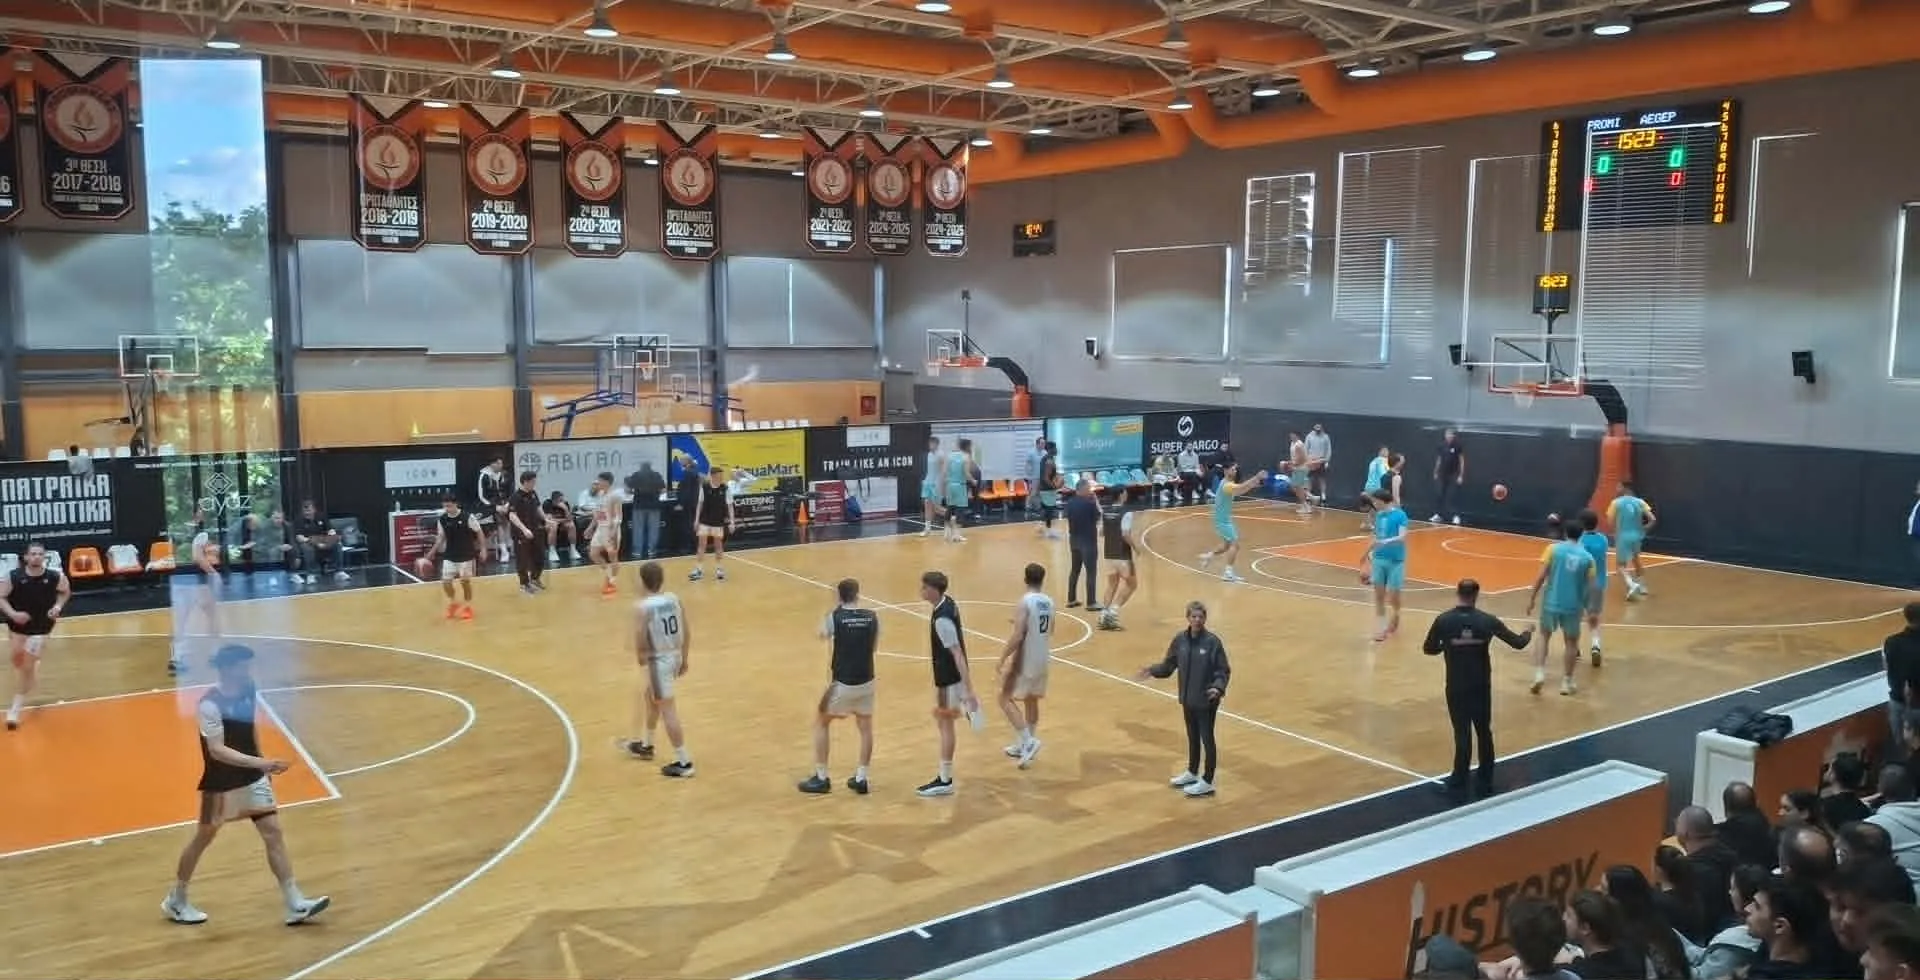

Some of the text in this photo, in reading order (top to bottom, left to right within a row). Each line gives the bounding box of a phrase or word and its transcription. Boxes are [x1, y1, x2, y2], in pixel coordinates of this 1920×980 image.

[1587, 111, 1677, 129] PROMI AEGEP
[1597, 148, 1683, 174] 0 0
[52, 172, 122, 192] 2017-2018
[1671, 172, 1682, 186] 0
[361, 208, 418, 225] 2018-2019
[471, 213, 528, 229] 2019-2020
[569, 217, 621, 233] 2020-2021
[666, 222, 714, 237] 2020-2021
[1151, 440, 1183, 454] SUPER
[878, 456, 889, 468] AN
[893, 455, 913, 467] ICON
[661, 615, 678, 636] 10
